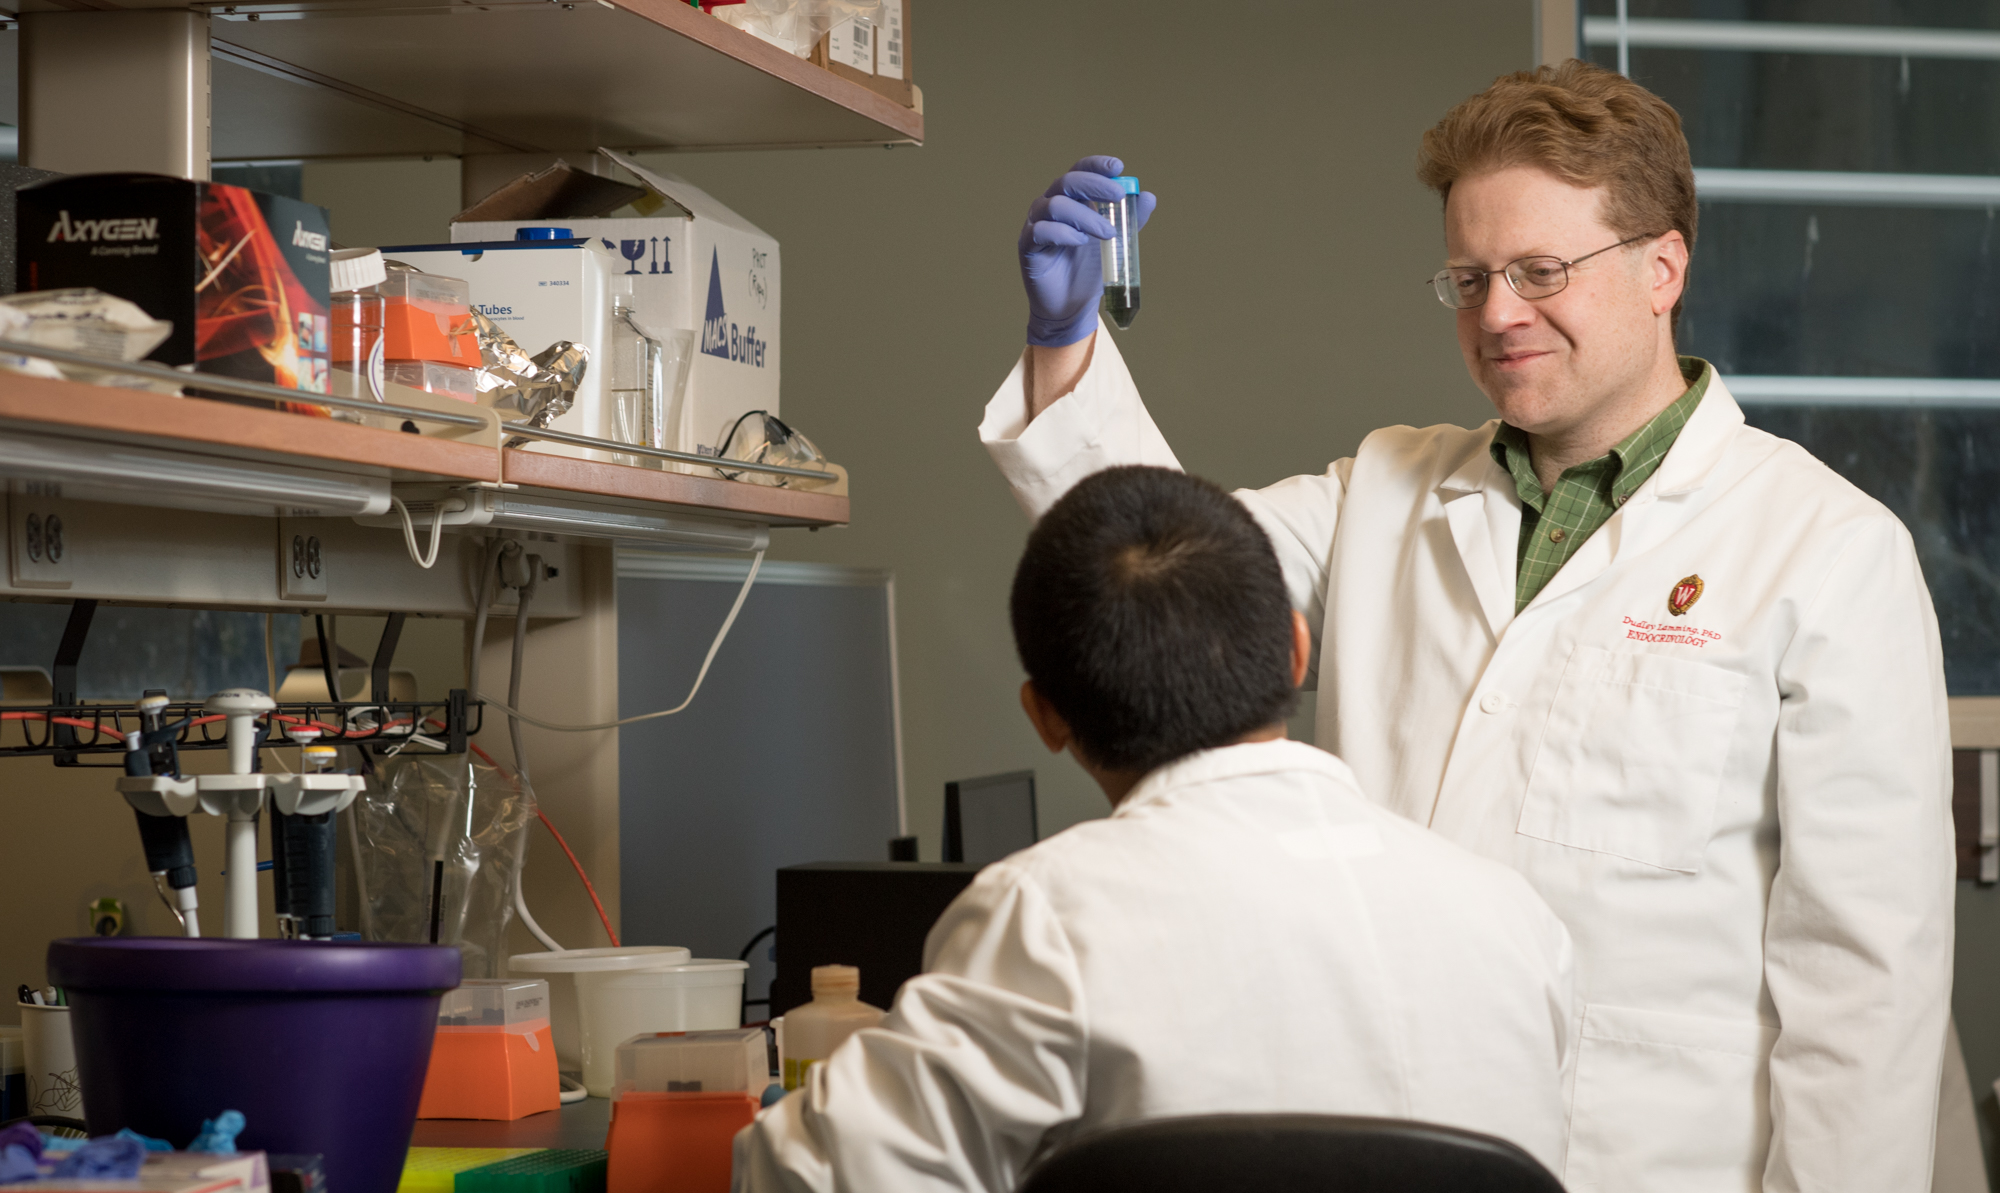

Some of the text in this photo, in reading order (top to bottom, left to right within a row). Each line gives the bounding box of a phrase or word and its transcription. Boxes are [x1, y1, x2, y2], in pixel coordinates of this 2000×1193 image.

[47, 210, 158, 242] AXYGEN
[478, 304, 512, 315] Tubes
[703, 313, 728, 353] MACS
[731, 323, 767, 369] Buffer
[1675, 586, 1695, 606] W
[1622, 616, 1656, 632] Dudley
[1701, 629, 1722, 641] PhD
[1626, 629, 1708, 648] ENDOCRINOLOGY
